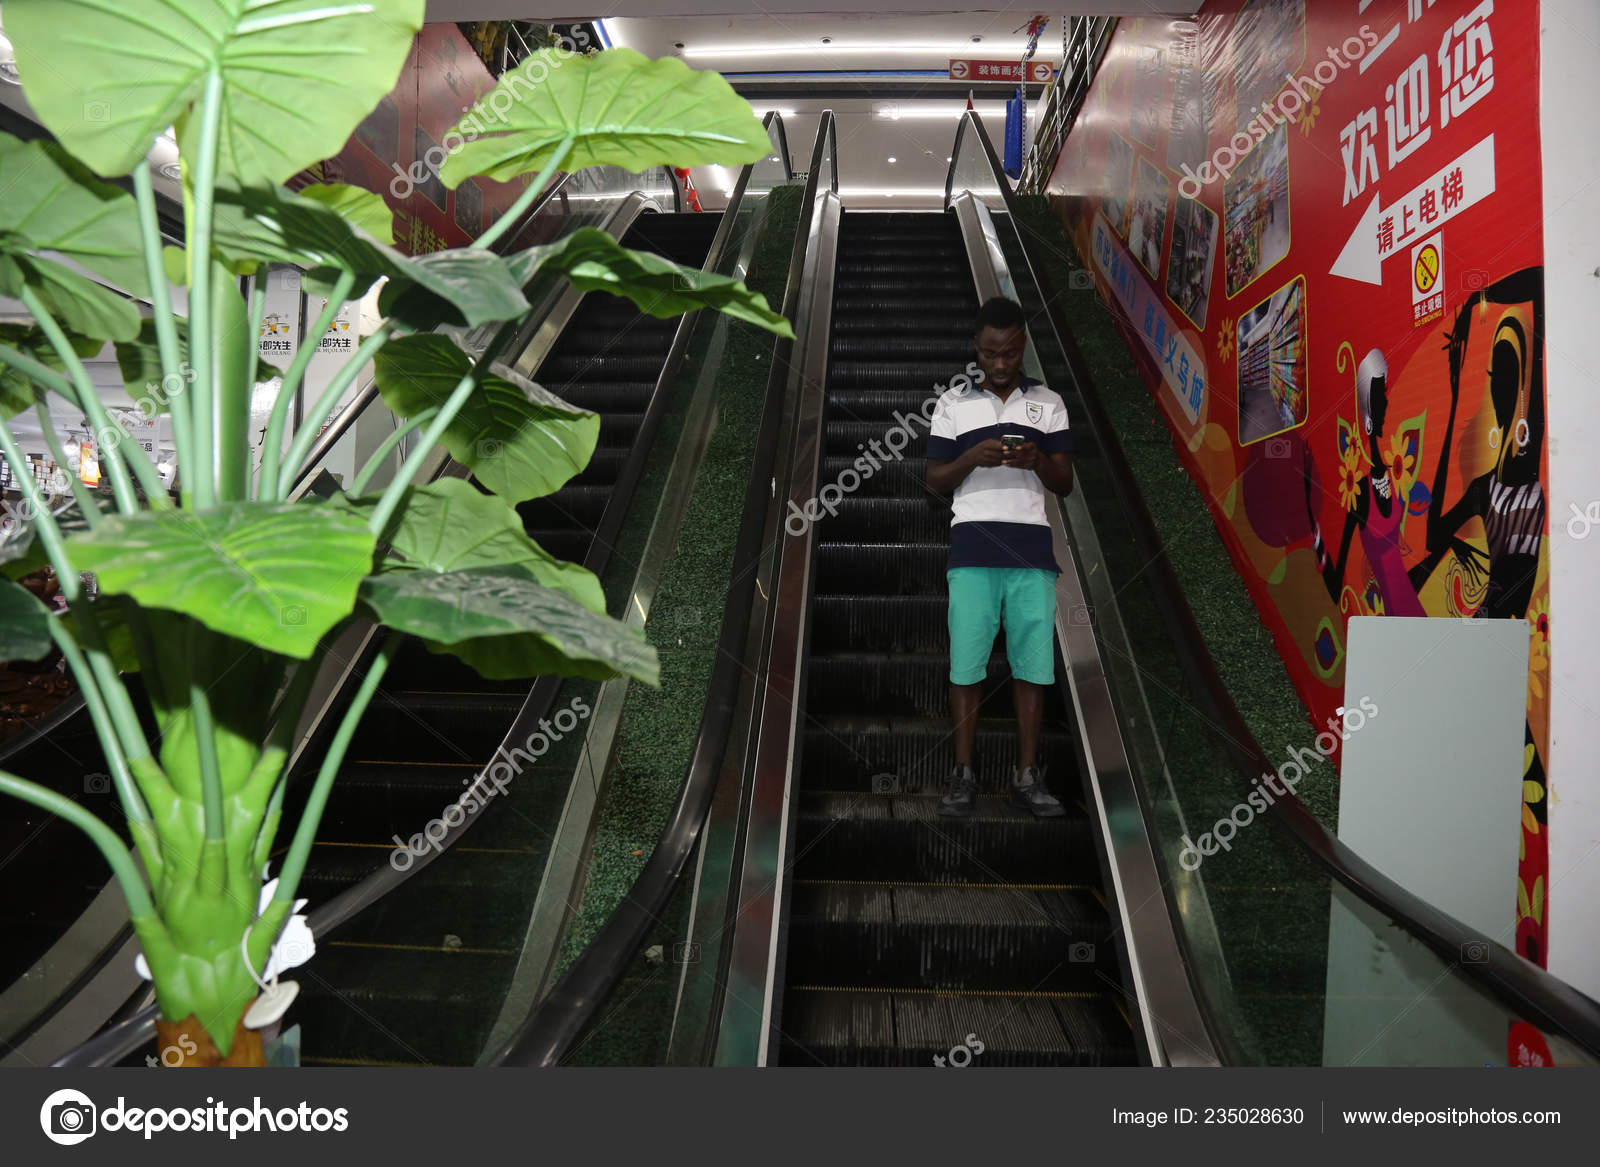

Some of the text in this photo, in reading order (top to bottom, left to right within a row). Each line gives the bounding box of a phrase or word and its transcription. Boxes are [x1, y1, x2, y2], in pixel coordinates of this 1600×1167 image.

[1339, 0, 1495, 208] 欢迎您
[1377, 167, 1464, 255] 请上电梯
[1414, 294, 1442, 320] 禁止吸烟
